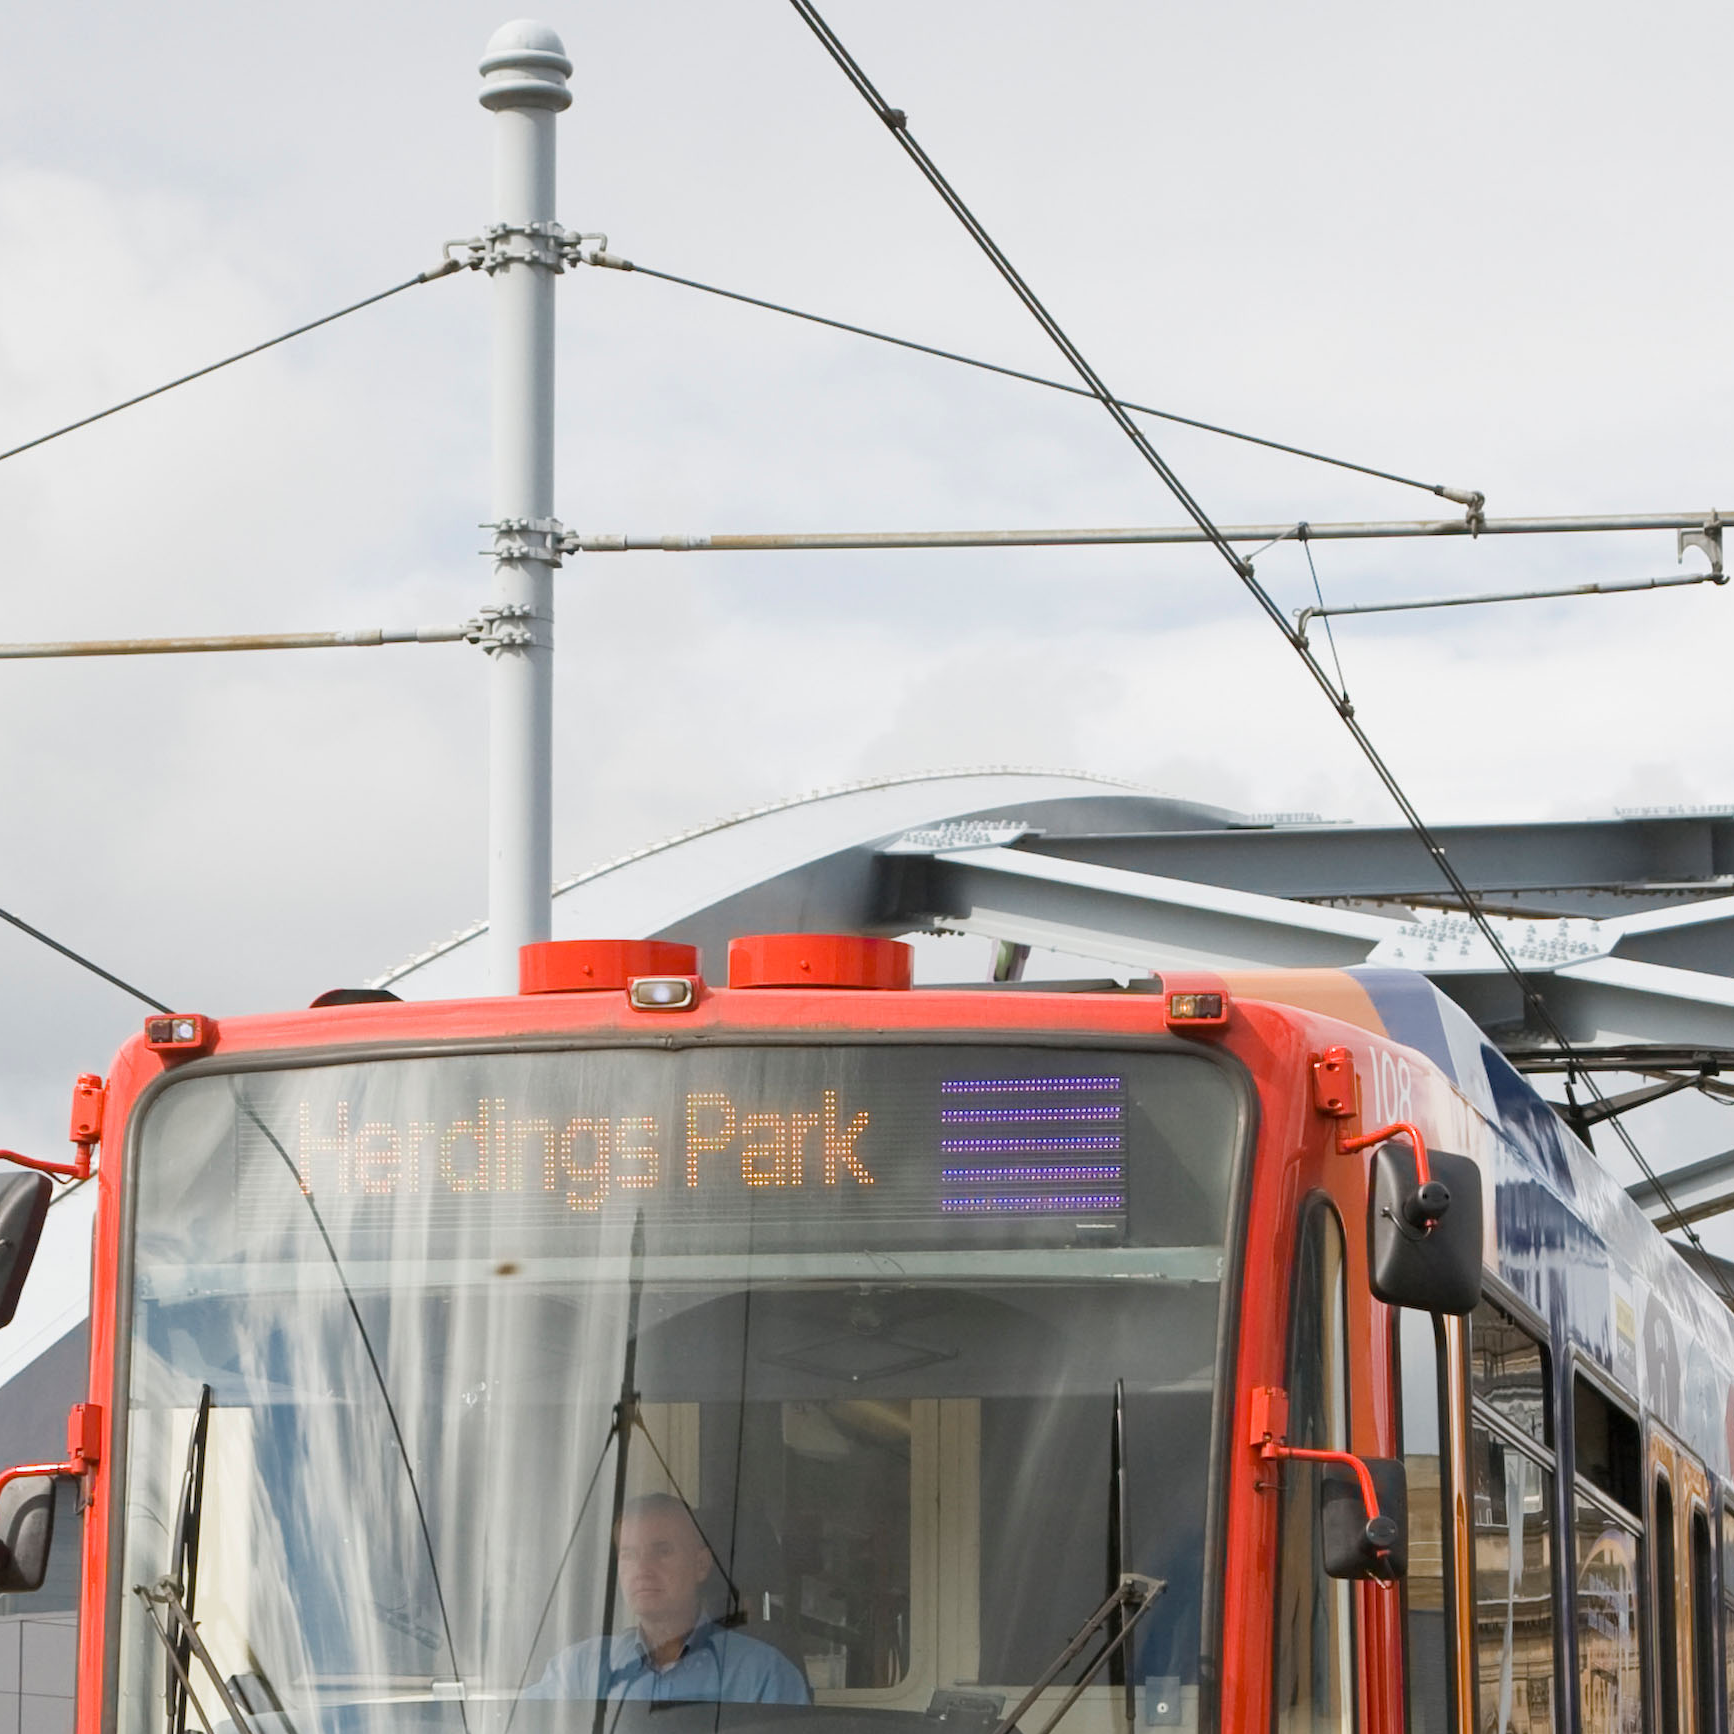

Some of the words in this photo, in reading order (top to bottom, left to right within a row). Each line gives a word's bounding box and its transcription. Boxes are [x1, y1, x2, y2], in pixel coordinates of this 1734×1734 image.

[1368, 1045, 1413, 1126] 108
[299, 1098, 659, 1211] Herdings
[685, 1090, 875, 1187] Park
